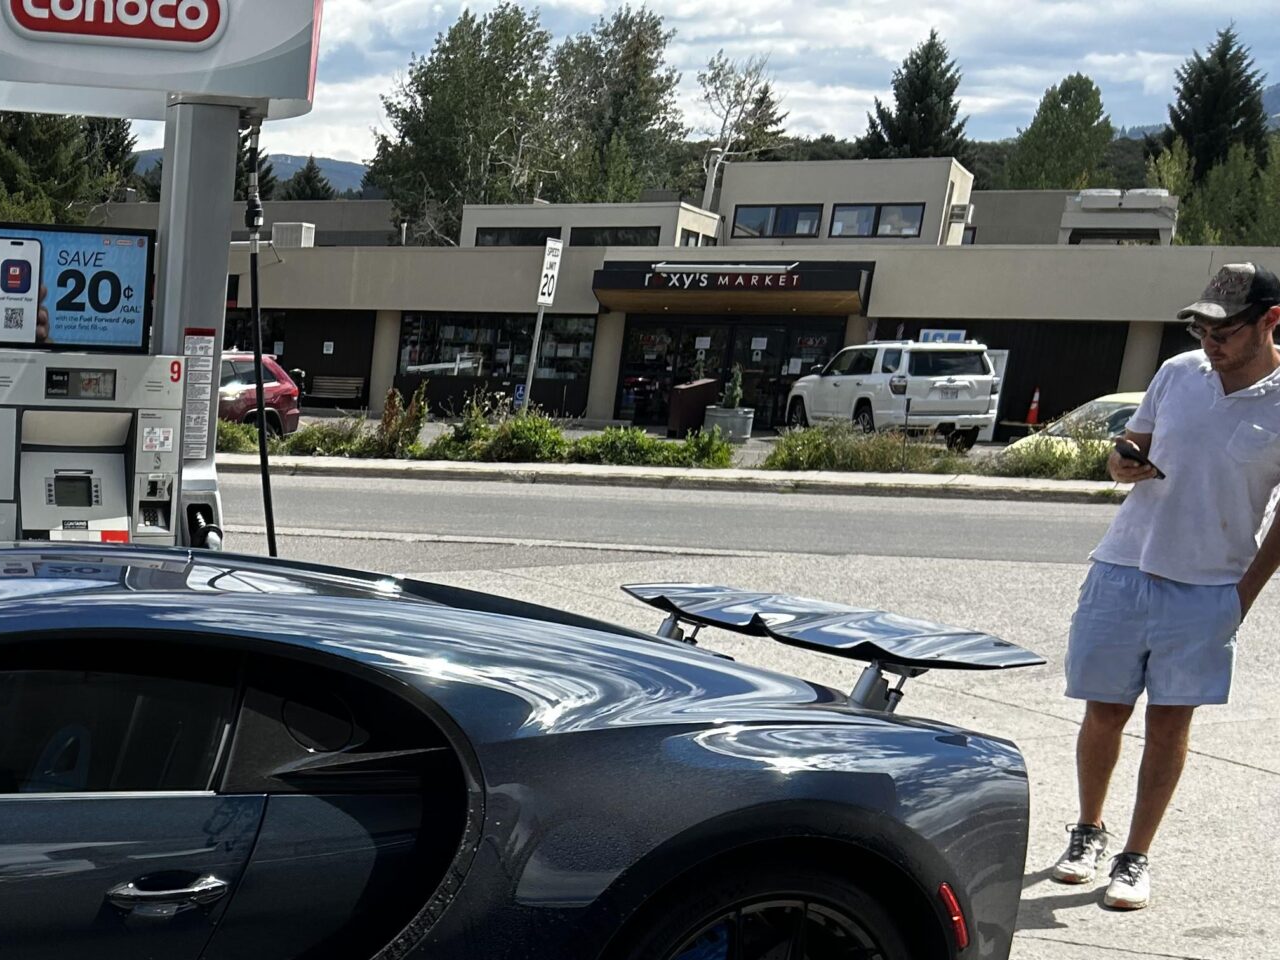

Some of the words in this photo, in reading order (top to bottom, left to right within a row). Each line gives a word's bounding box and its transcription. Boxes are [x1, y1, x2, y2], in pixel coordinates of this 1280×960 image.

[547, 246, 560, 257] SPEED
[57, 250, 106, 267] SAVE
[546, 261, 557, 271] LIMIT
[540, 273, 555, 298] 20
[717, 274, 799, 286] MARKET
[122, 317, 136, 325] App
[170, 360, 182, 382] 9
